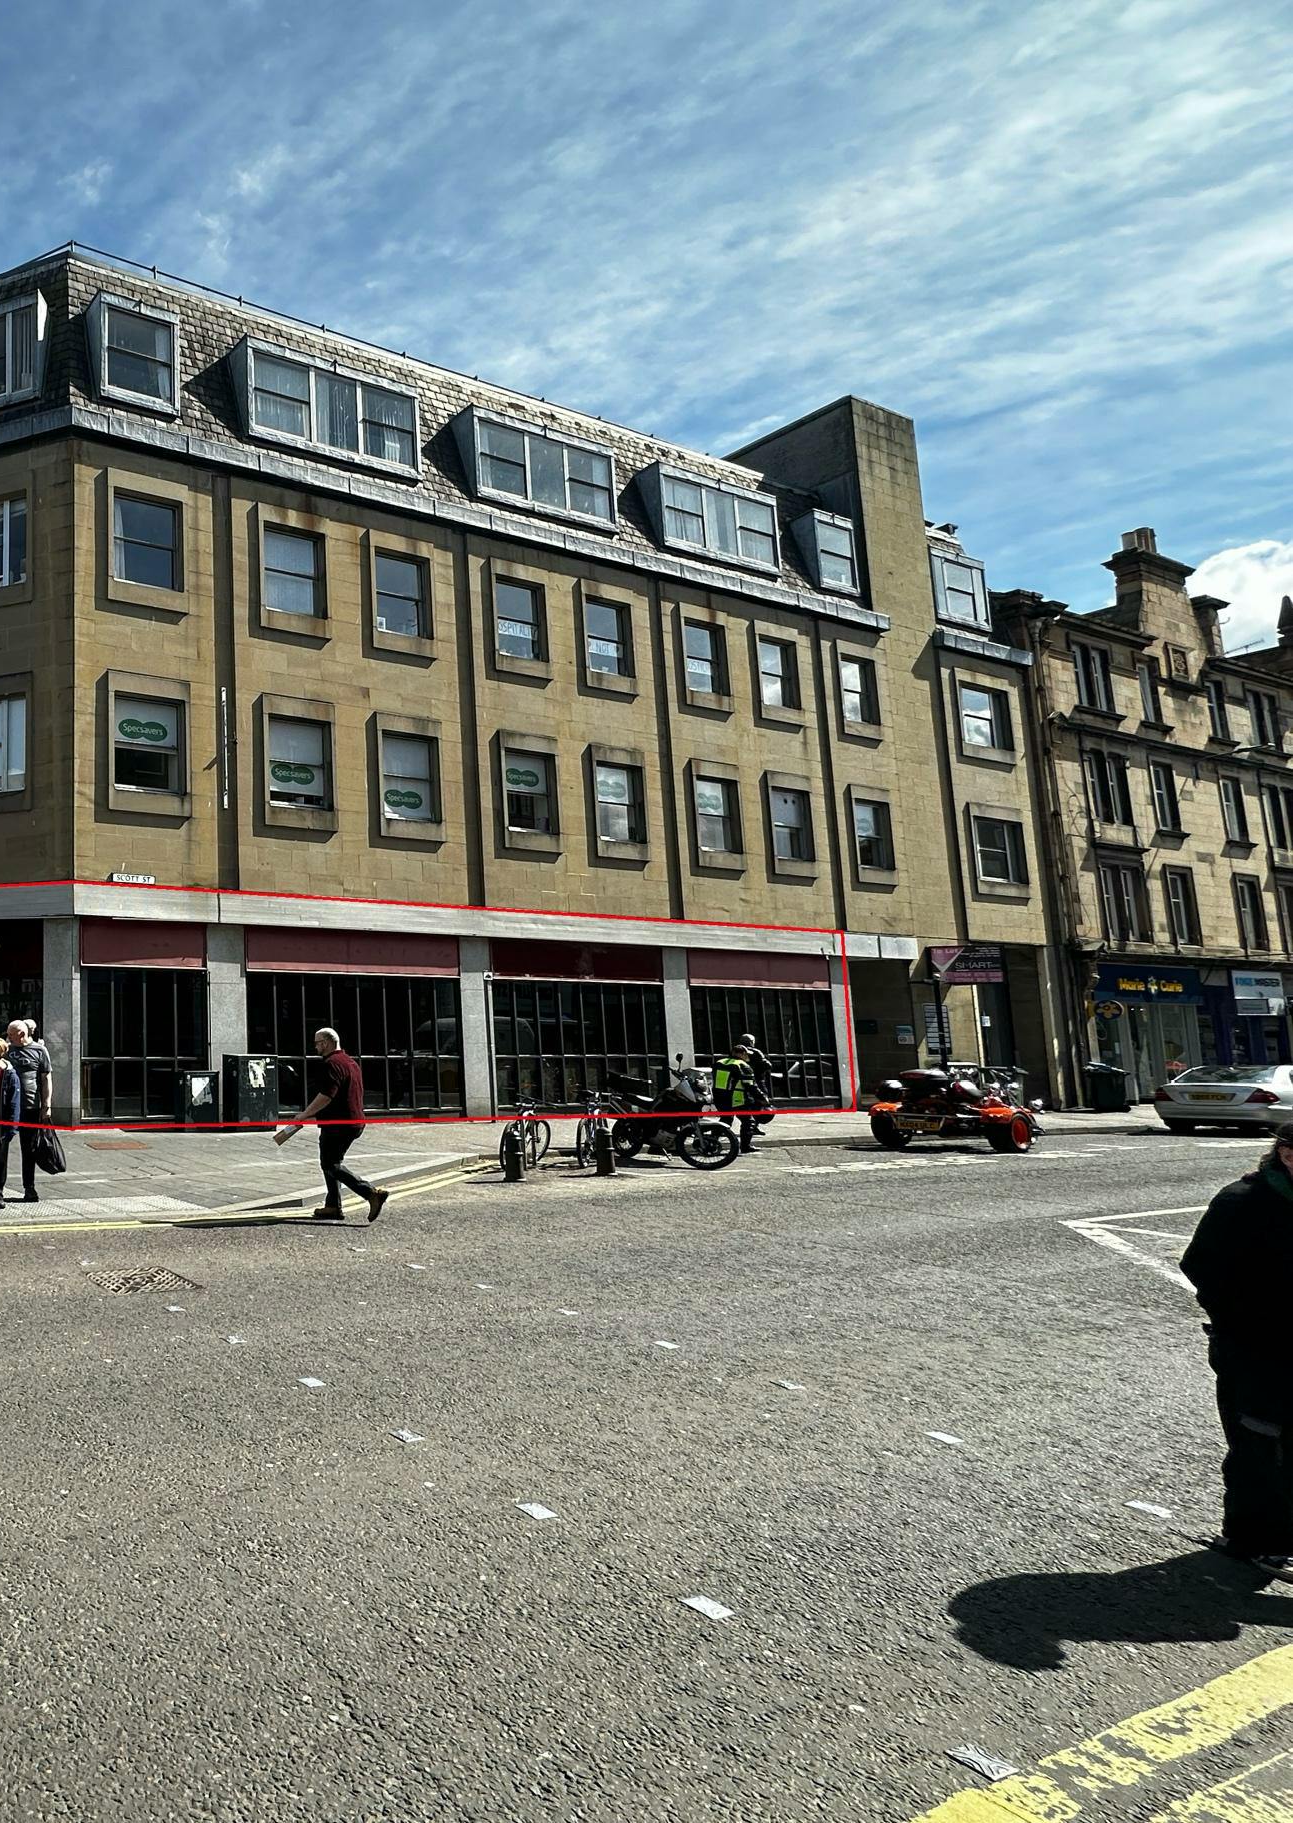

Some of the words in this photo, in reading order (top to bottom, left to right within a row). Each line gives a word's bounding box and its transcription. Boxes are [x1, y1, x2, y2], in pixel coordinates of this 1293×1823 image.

[122, 722, 164, 736] Specsavers
[274, 767, 312, 780] Specsavers
[386, 792, 420, 804] Specsavers
[116, 874, 139, 883] SCOTT
[954, 961, 992, 969] SMART
[1118, 978, 1146, 991] Marie
[1160, 980, 1183, 993] Curie
